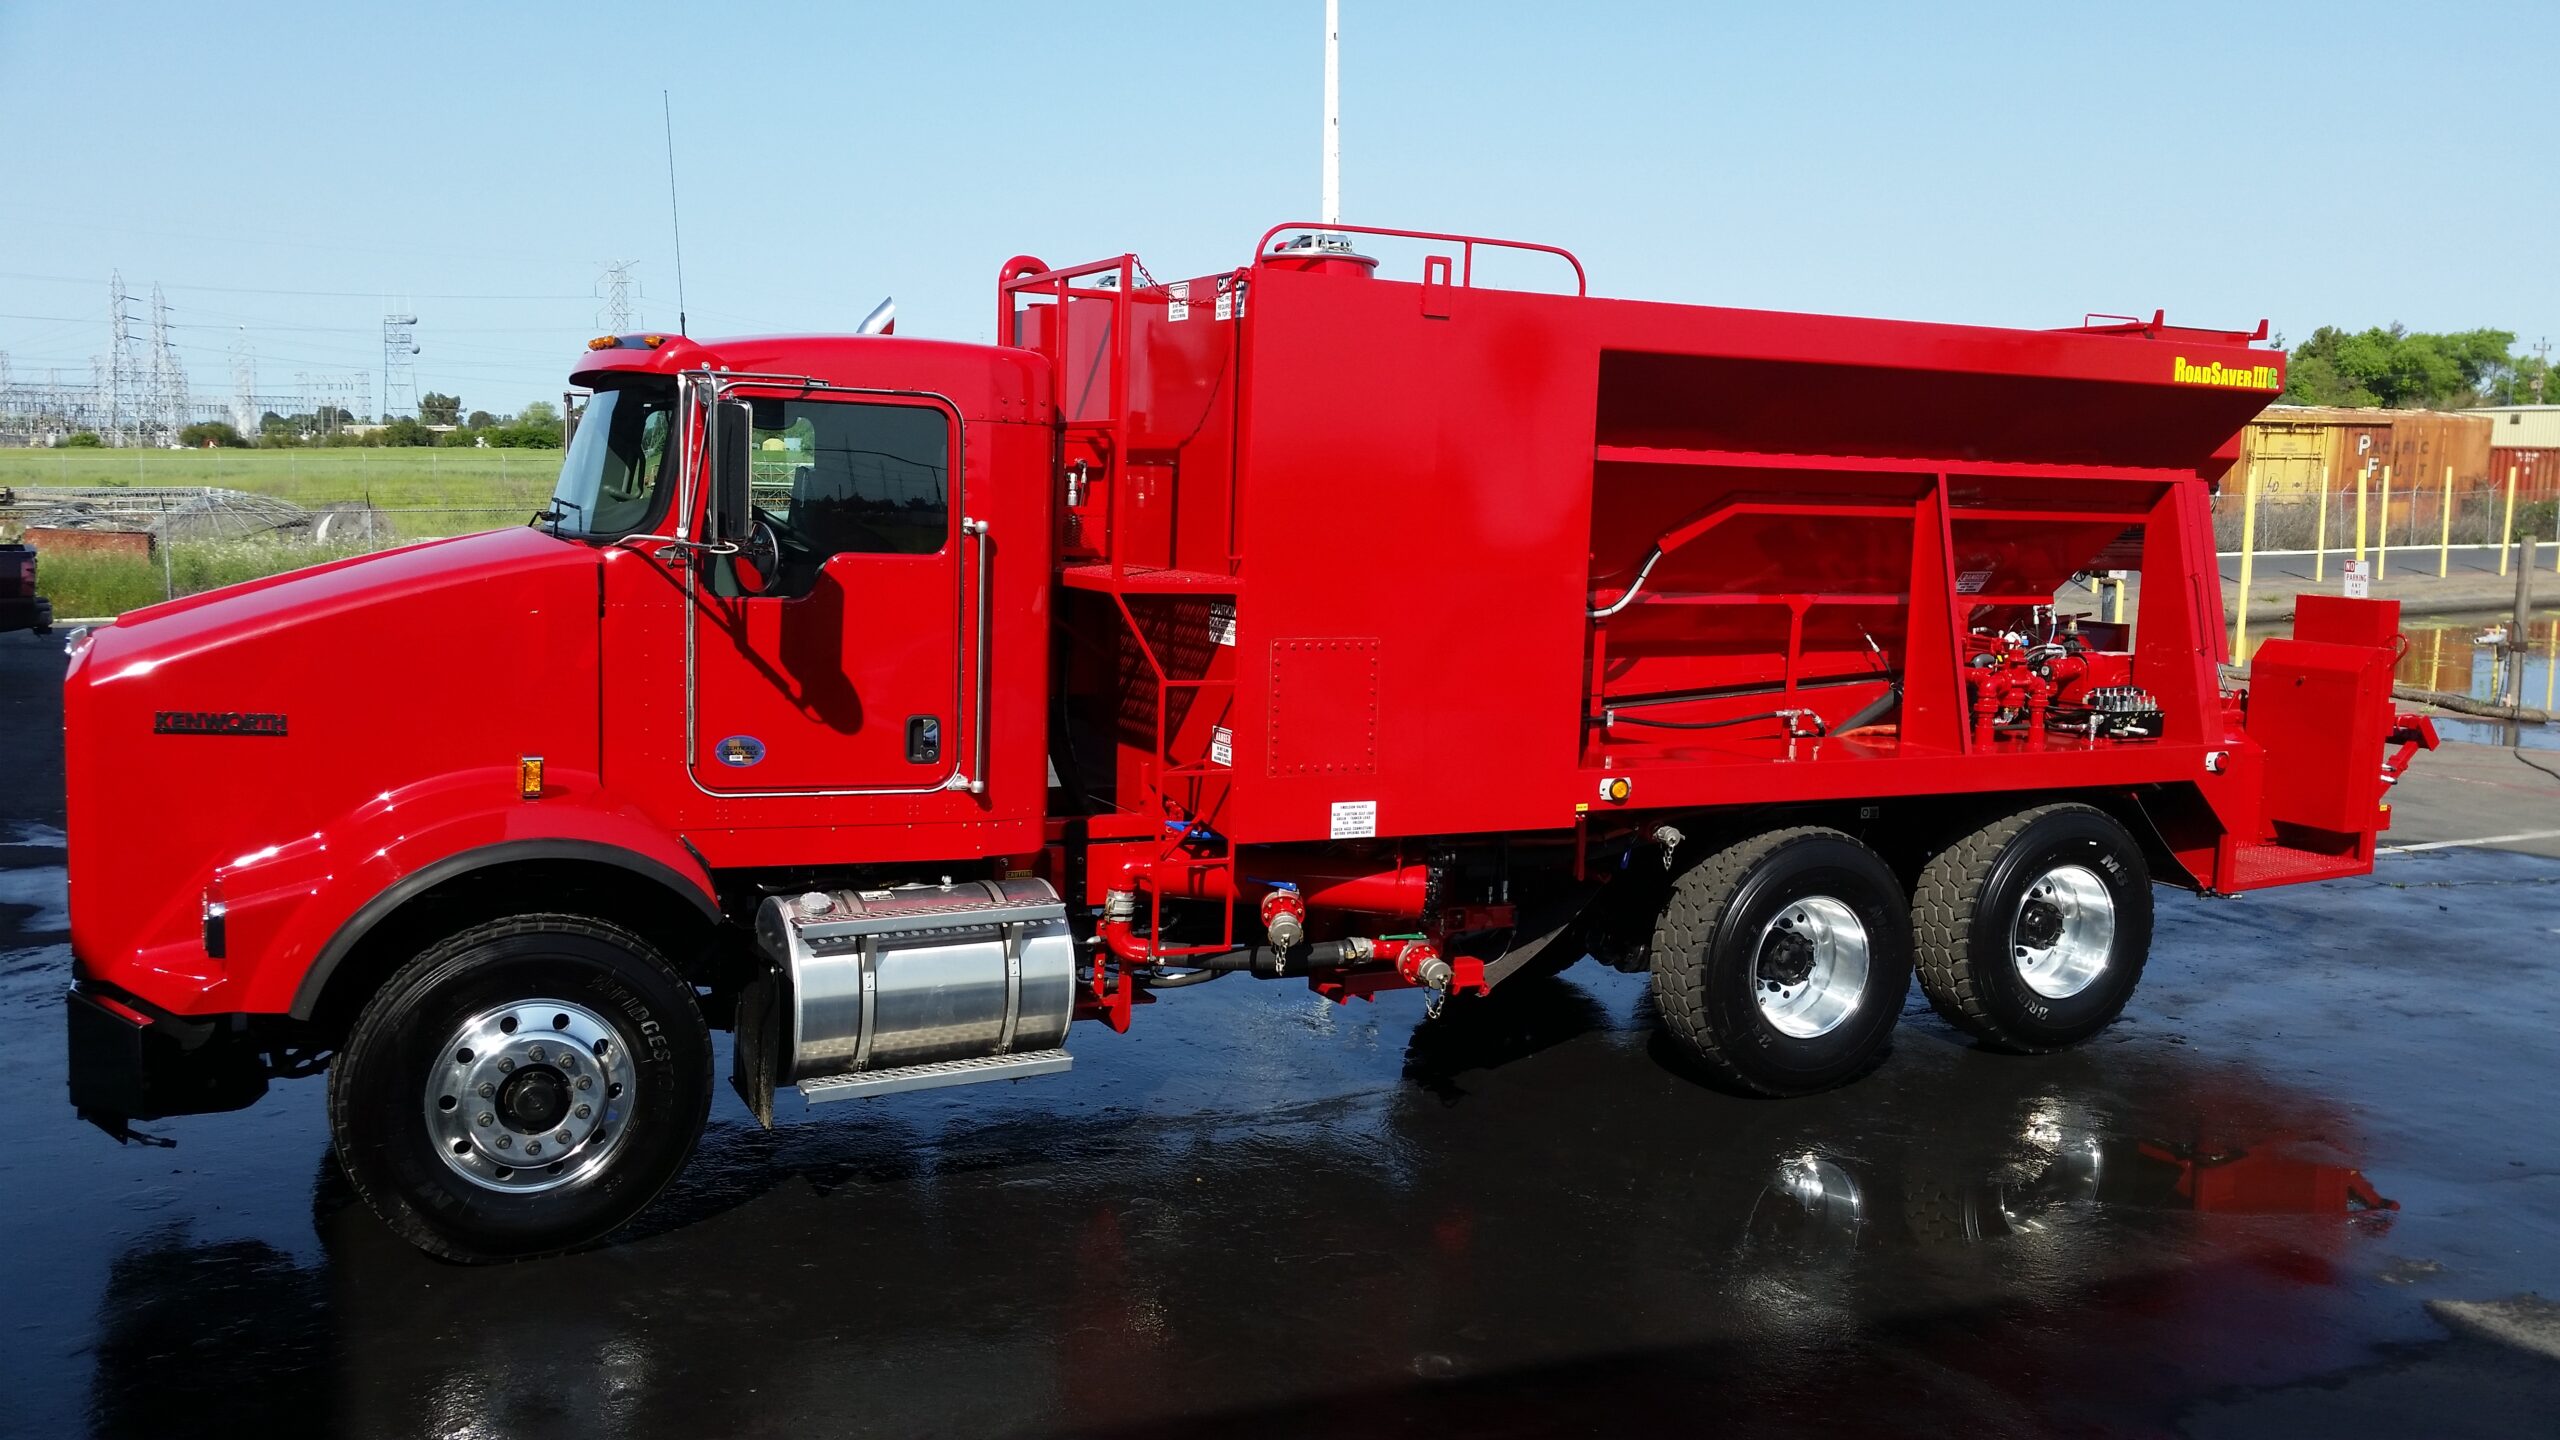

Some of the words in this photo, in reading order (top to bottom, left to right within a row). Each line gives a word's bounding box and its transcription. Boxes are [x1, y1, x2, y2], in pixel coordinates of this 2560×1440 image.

[2358, 434, 2430, 456] PACIFIC
[2345, 561, 2355, 572] NO
[2346, 573, 2367, 583] PARKING
[155, 711, 287, 731] KENWORTH
